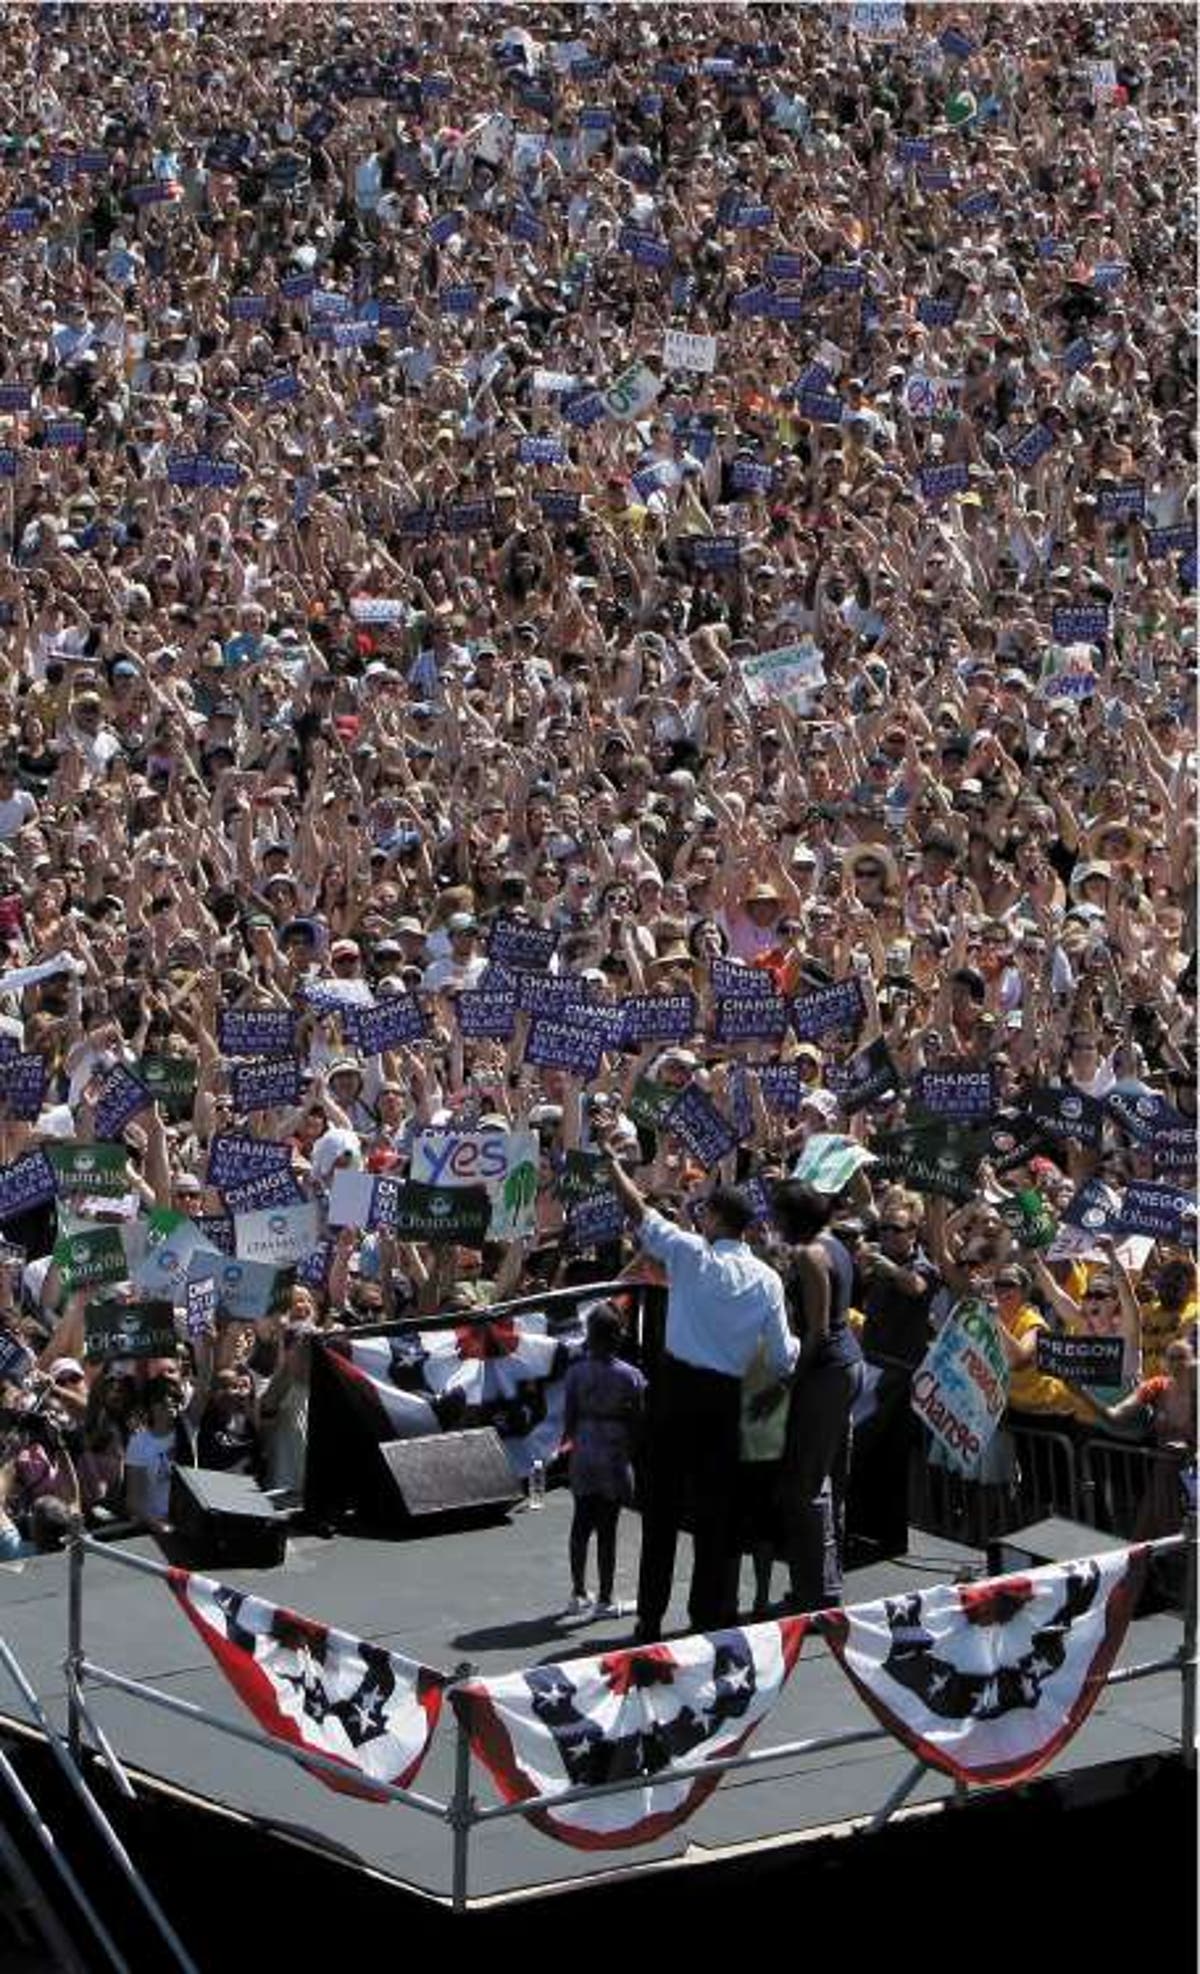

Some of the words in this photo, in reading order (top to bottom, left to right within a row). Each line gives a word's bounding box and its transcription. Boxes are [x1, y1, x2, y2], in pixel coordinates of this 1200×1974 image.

[461, 992, 514, 1004] CHANG
[722, 998, 784, 1011] CHANGE
[923, 1073, 991, 1086] CHANGE
[225, 1169, 289, 1205] CHANGE
